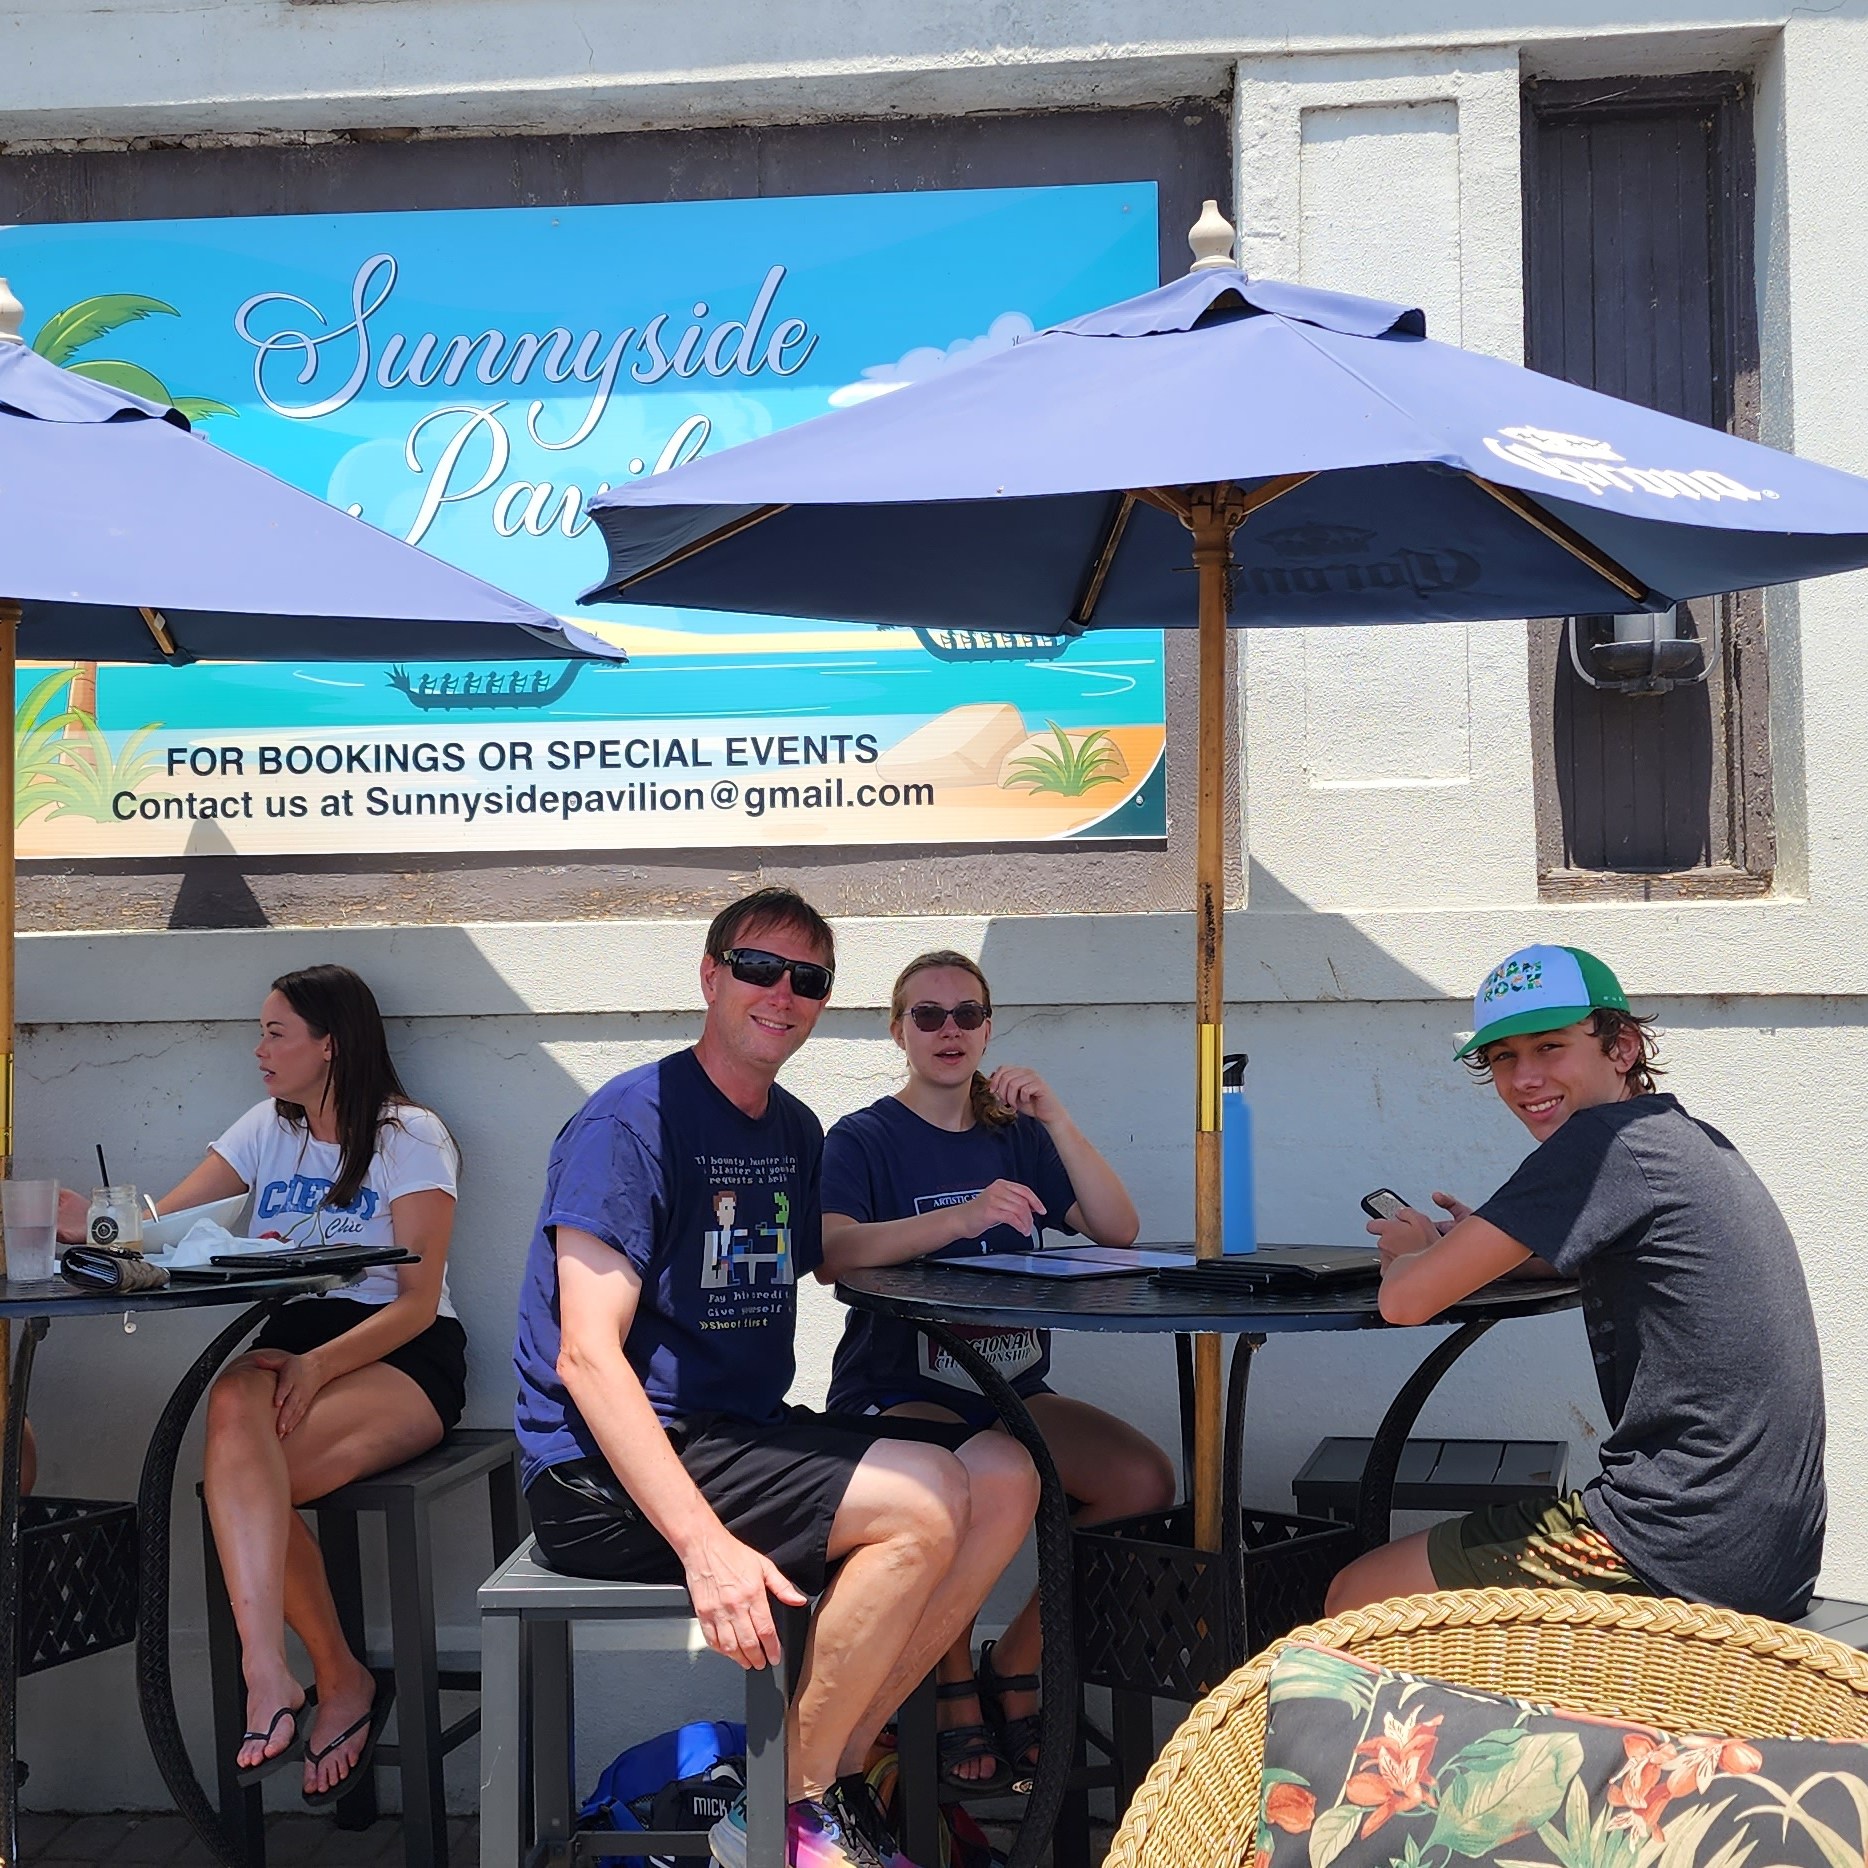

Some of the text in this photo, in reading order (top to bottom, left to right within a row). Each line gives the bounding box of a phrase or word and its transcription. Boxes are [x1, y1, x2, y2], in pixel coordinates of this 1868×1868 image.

[234, 252, 819, 450] Sunnyside
[404, 400, 712, 546] Pavl
[166, 734, 879, 777] FOR BOOKINGS OR SPECIAL EVENTS
[111, 778, 934, 823] Contact us at Sunnysidepavilion@gmail.com
[710, 1156, 745, 1167] bounty
[711, 1165, 751, 1175] blaster
[709, 1176, 753, 1185] requests
[933, 1194, 970, 1208] ARTISTIC
[324, 1216, 364, 1239] Chic
[708, 1294, 727, 1304] Pay
[707, 1307, 735, 1317] Give
[938, 1331, 1030, 1358] GIONAL
[693, 1796, 728, 1817] MICK
